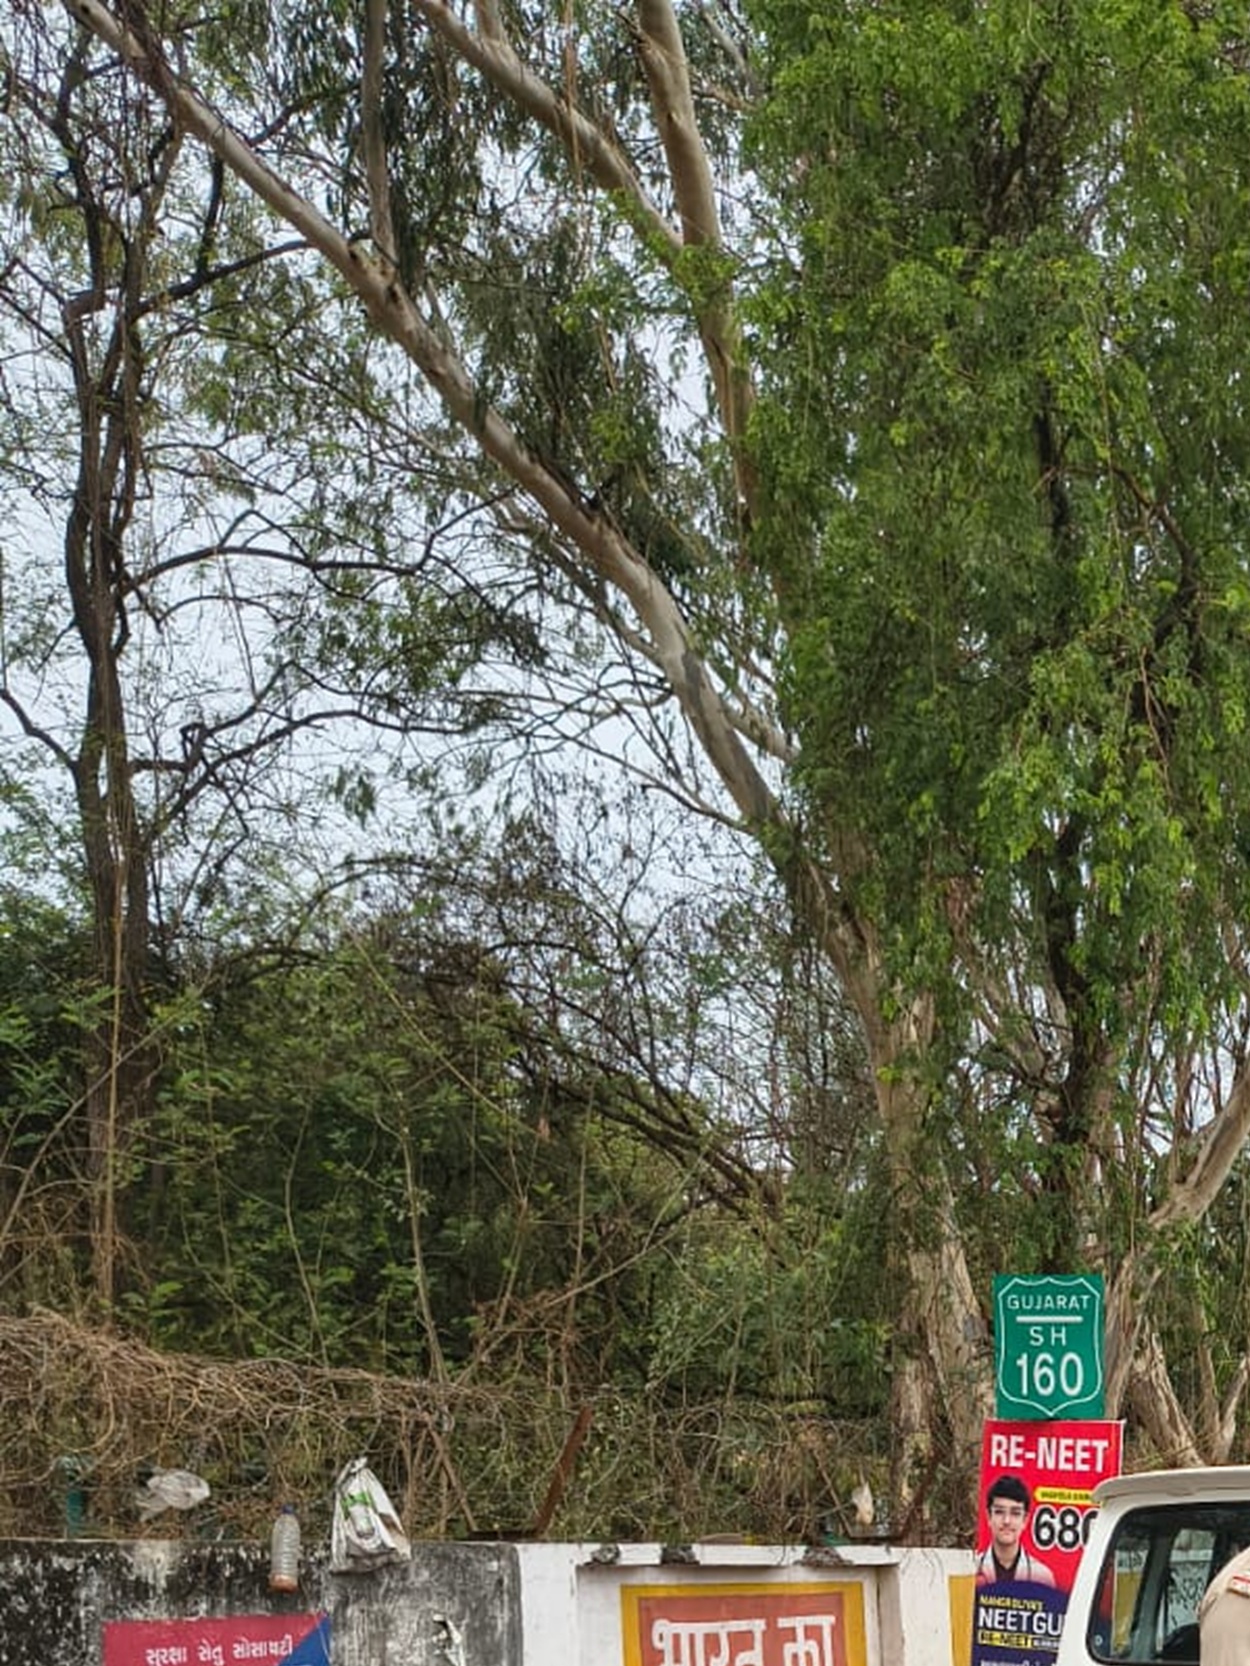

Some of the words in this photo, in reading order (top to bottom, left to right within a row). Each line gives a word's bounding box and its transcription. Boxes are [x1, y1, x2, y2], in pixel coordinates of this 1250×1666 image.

[1007, 1295, 1091, 1310] GUJARAT
[1016, 1353, 1083, 1396] 160
[991, 1434, 1109, 1473] RE-NEET
[198, 1639, 225, 1666] સેતુ
